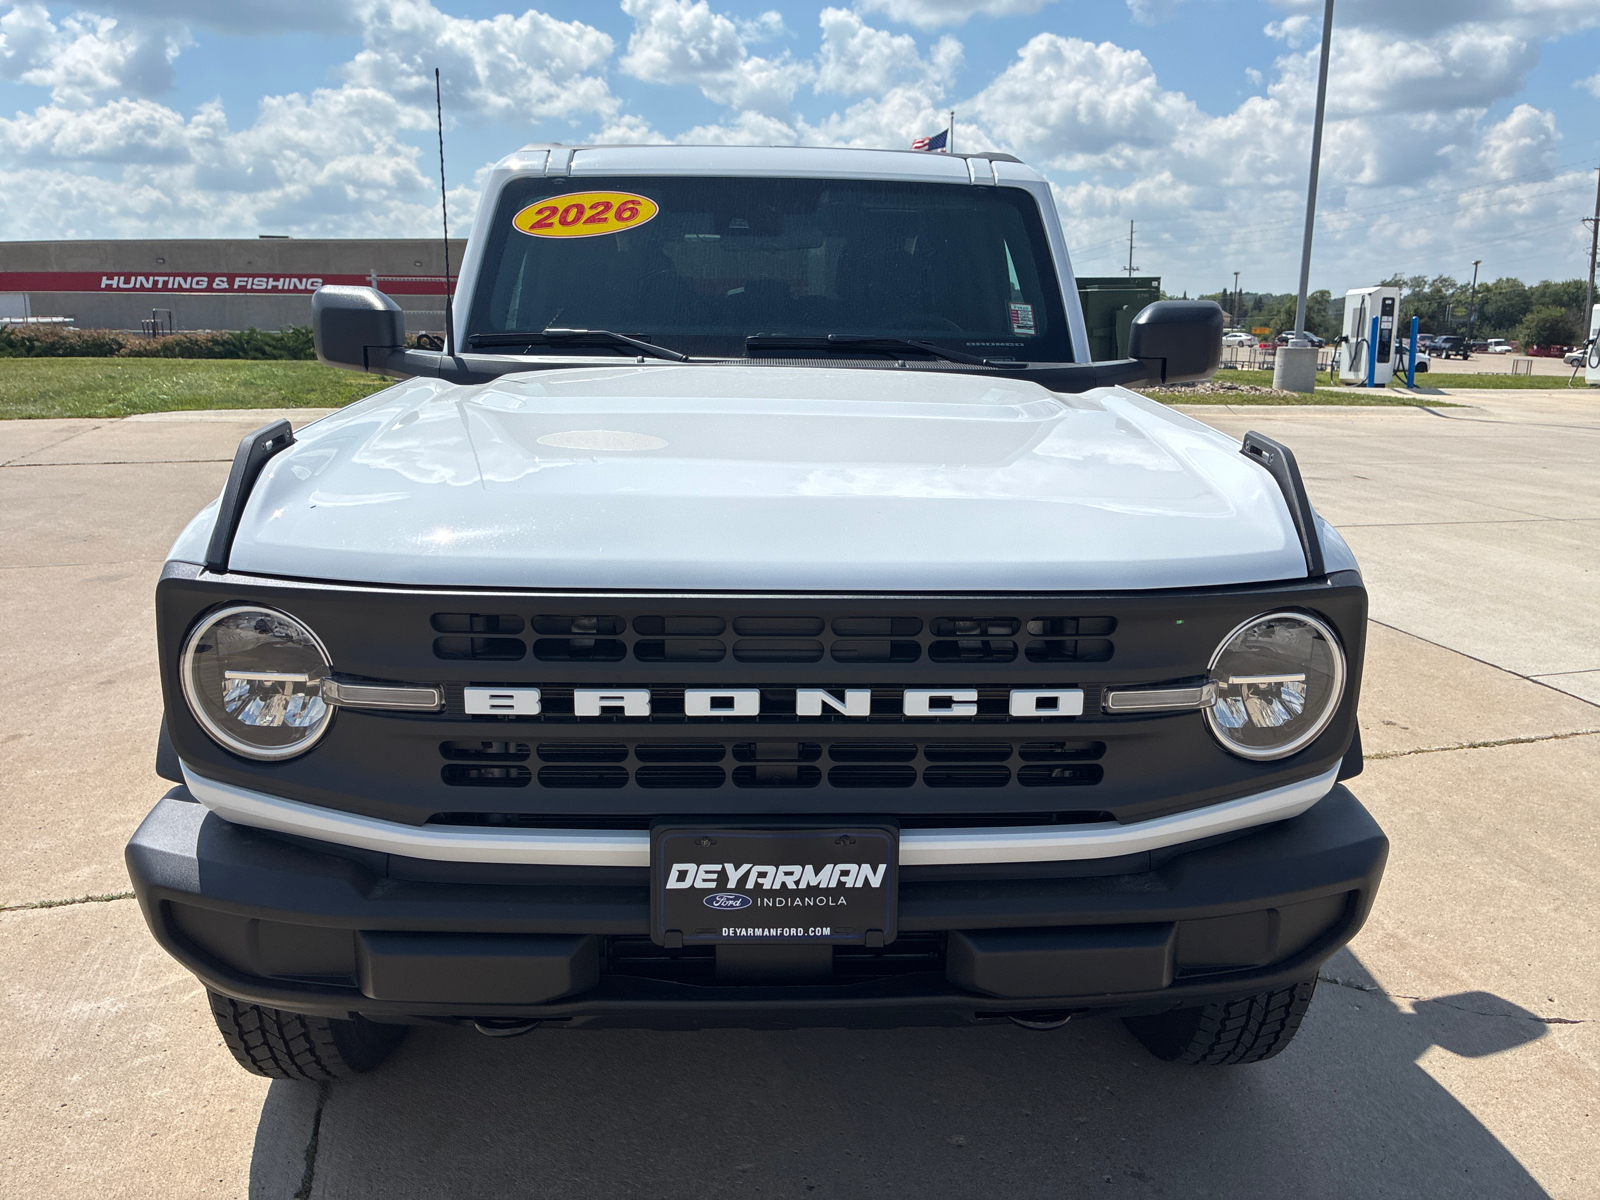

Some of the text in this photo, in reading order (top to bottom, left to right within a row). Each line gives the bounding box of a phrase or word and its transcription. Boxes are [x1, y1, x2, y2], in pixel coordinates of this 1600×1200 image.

[528, 199, 642, 231] 2026
[100, 275, 323, 290] HUNTING & FISHING
[463, 686, 1085, 717] BRONCO
[665, 862, 887, 890] DEYARMAN
[712, 895, 848, 908] Ford INDIANOLA
[721, 926, 832, 938] DEYARMANFORD.COM
